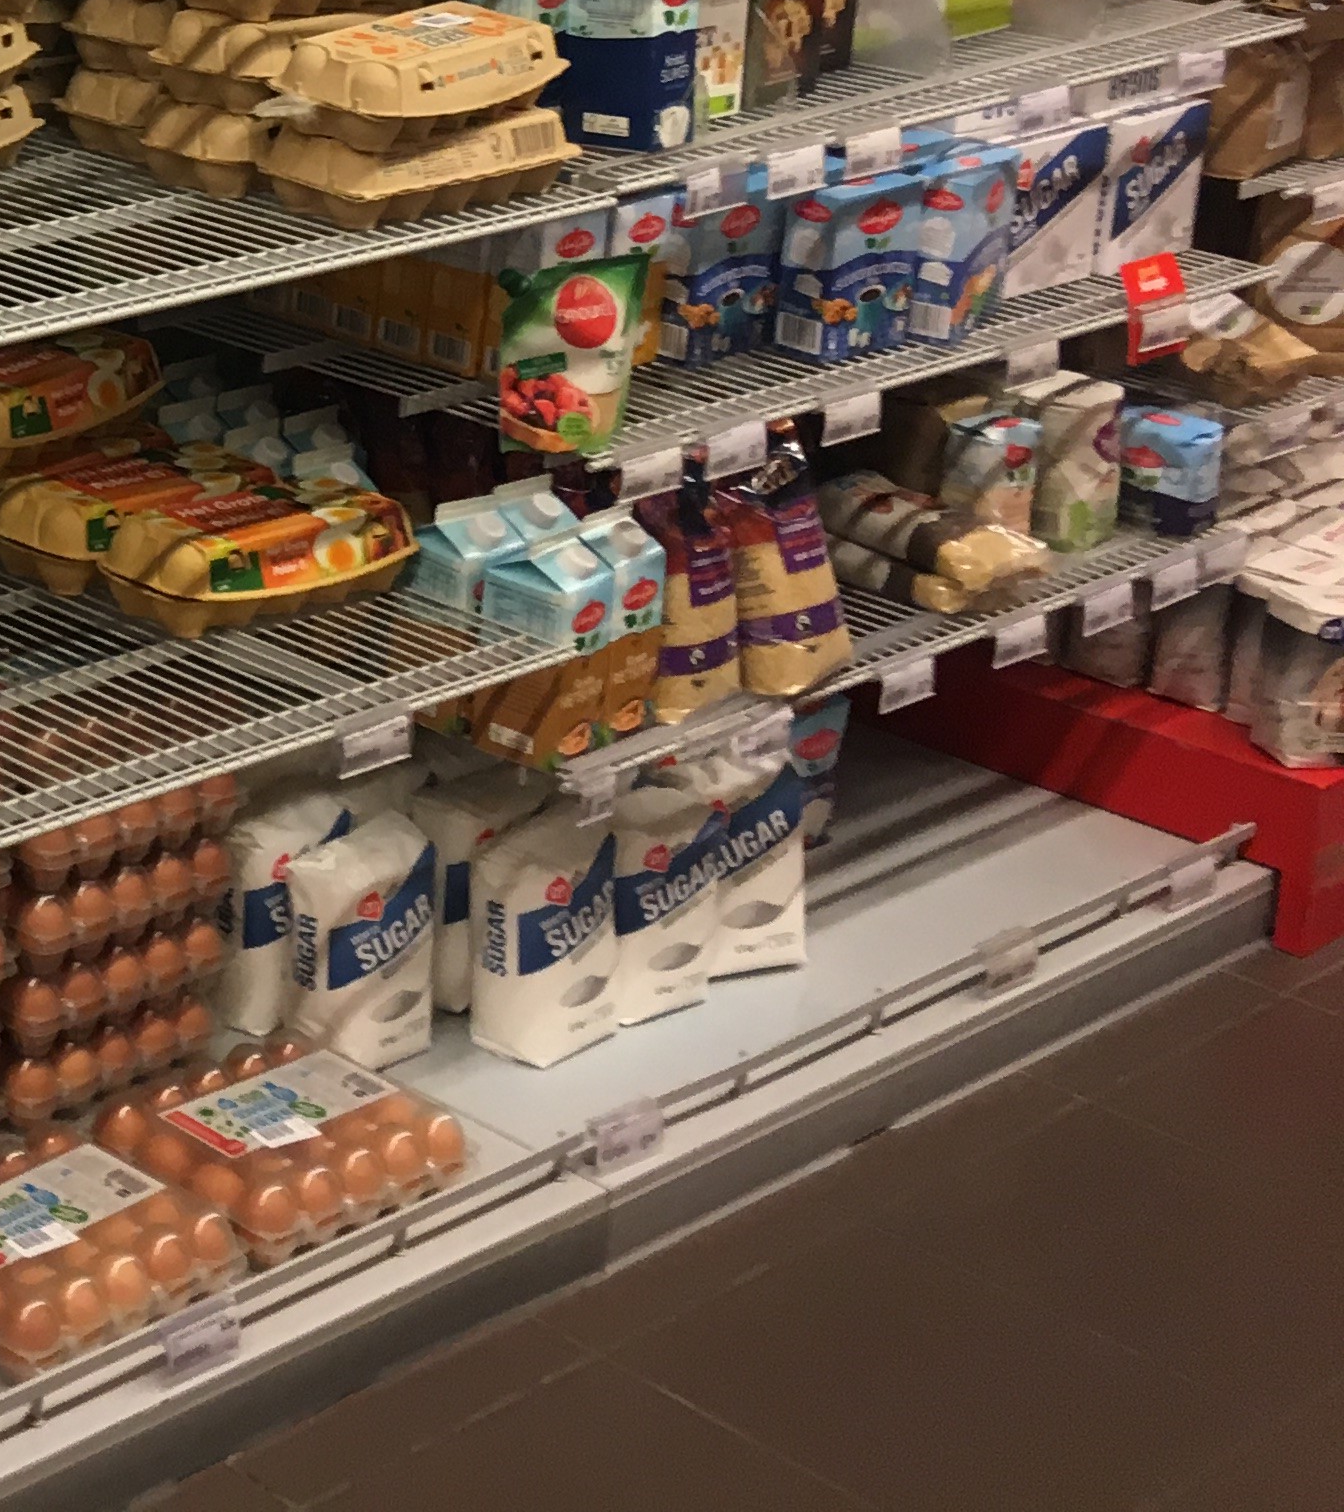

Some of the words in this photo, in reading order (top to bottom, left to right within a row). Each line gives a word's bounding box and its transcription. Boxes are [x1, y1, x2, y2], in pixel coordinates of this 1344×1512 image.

[717, 808, 790, 872] UGAR
[354, 892, 434, 973] SUGAR
[486, 899, 508, 978] SUGAR
